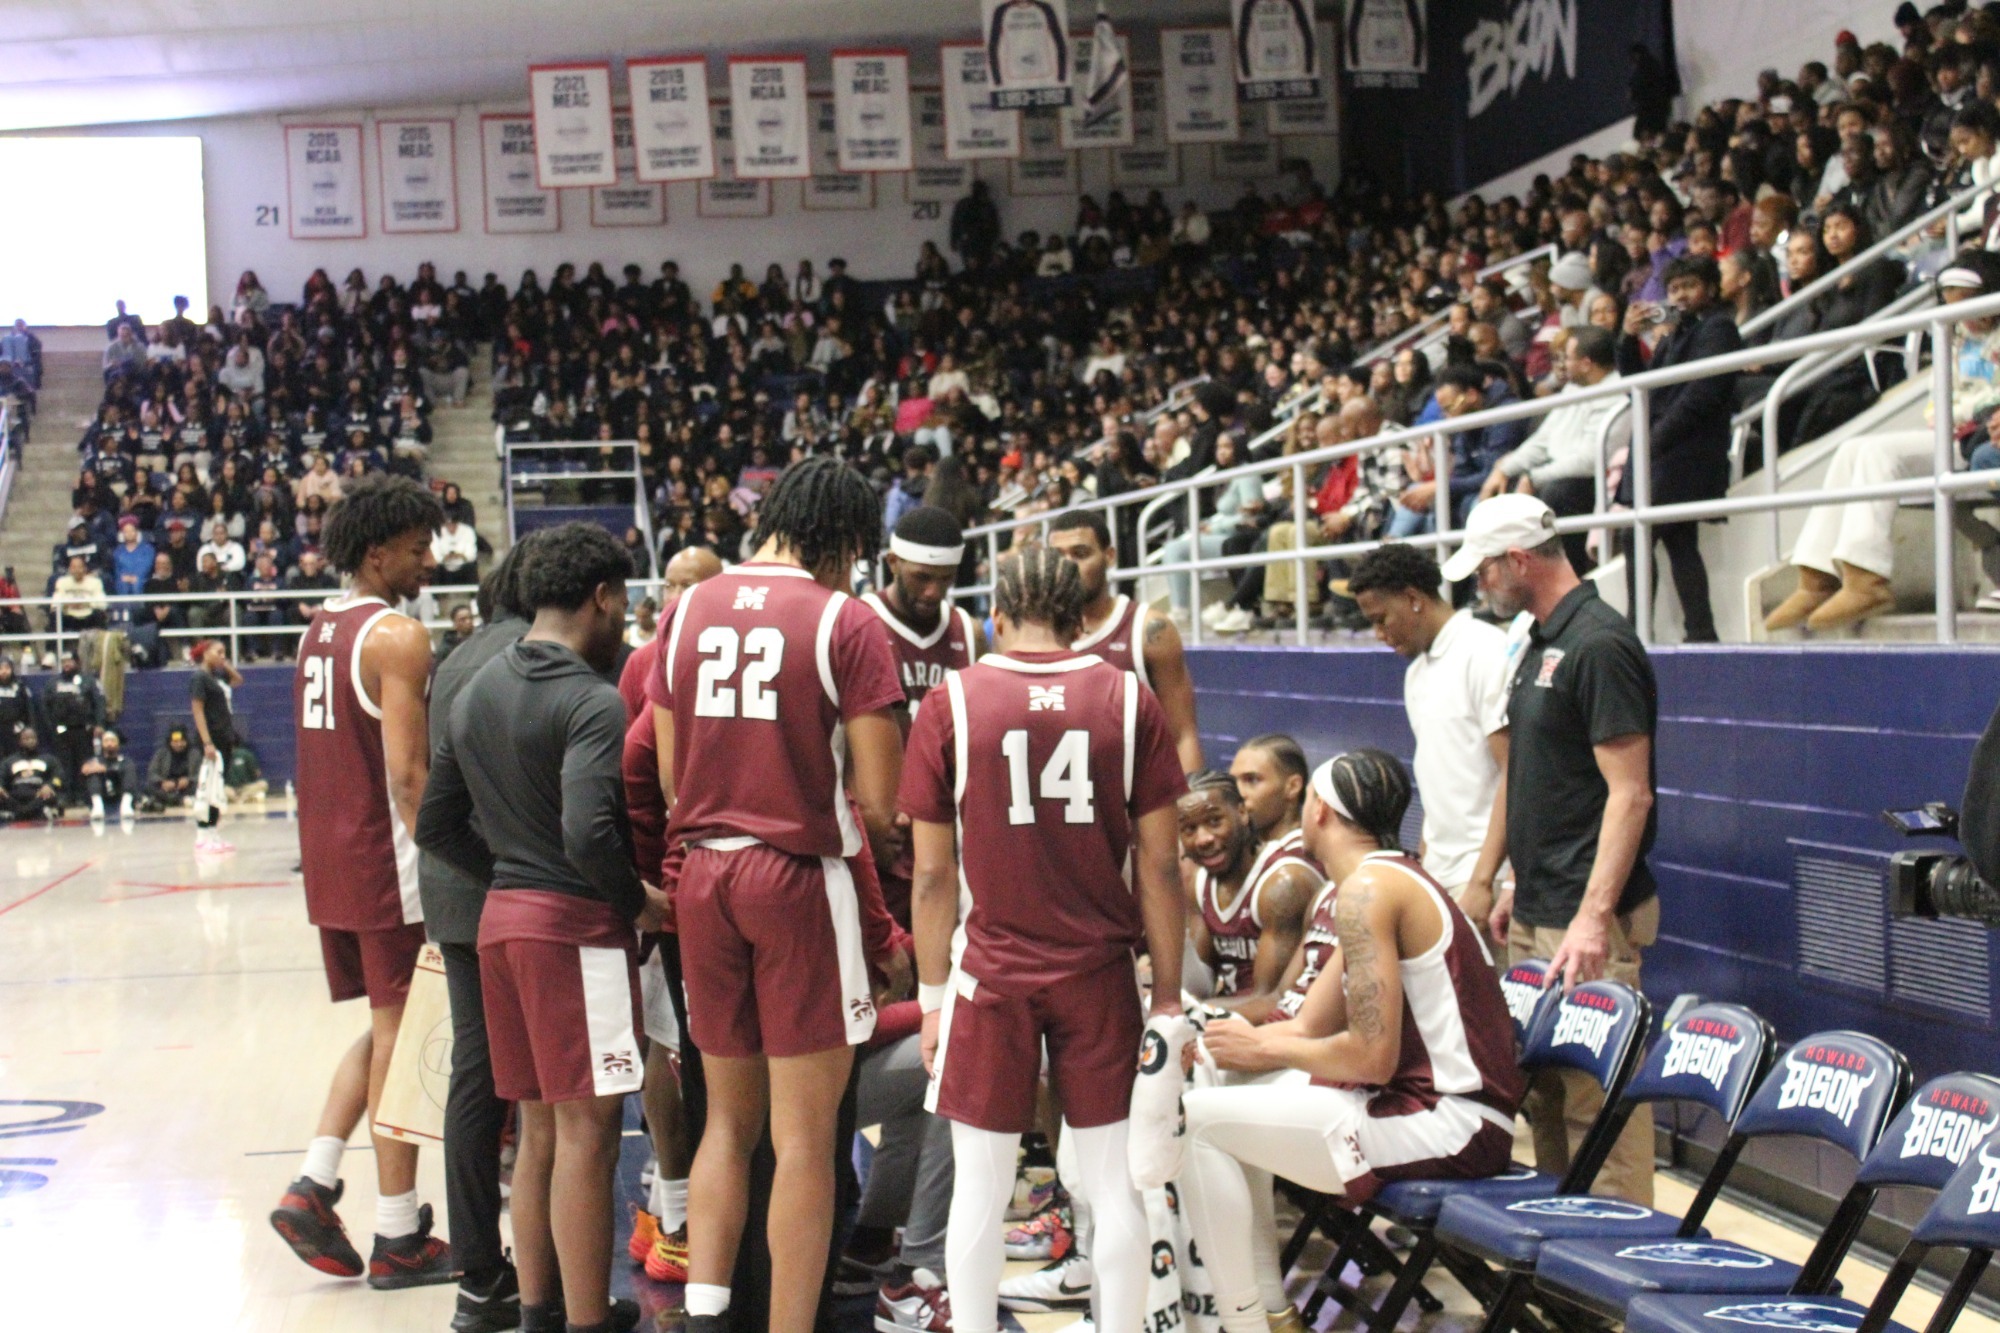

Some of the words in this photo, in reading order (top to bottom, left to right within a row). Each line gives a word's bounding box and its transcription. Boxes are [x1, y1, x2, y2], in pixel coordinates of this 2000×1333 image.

[553, 76, 586, 92] 2021
[650, 87, 687, 102] MEAC
[750, 86, 786, 99] NCAA
[552, 92, 590, 108] MEAC
[308, 132, 339, 147] 2015
[306, 149, 341, 163] NCAA
[398, 143, 433, 158] MEAC
[256, 205, 279, 226] 21
[694, 626, 785, 721] 22
[303, 656, 335, 730] 21
[1002, 729, 1095, 825] 14
[1574, 991, 1617, 1012] HOWARD
[1551, 997, 1622, 1060] BISON
[1687, 1018, 1738, 1039] HOWARD
[1662, 1023, 1745, 1092] BISON
[1805, 1046, 1866, 1071] HOWARD
[1777, 1050, 1876, 1128] BISON
[1930, 1088, 1988, 1116] HOWARD
[1900, 1093, 1999, 1168] BISON
